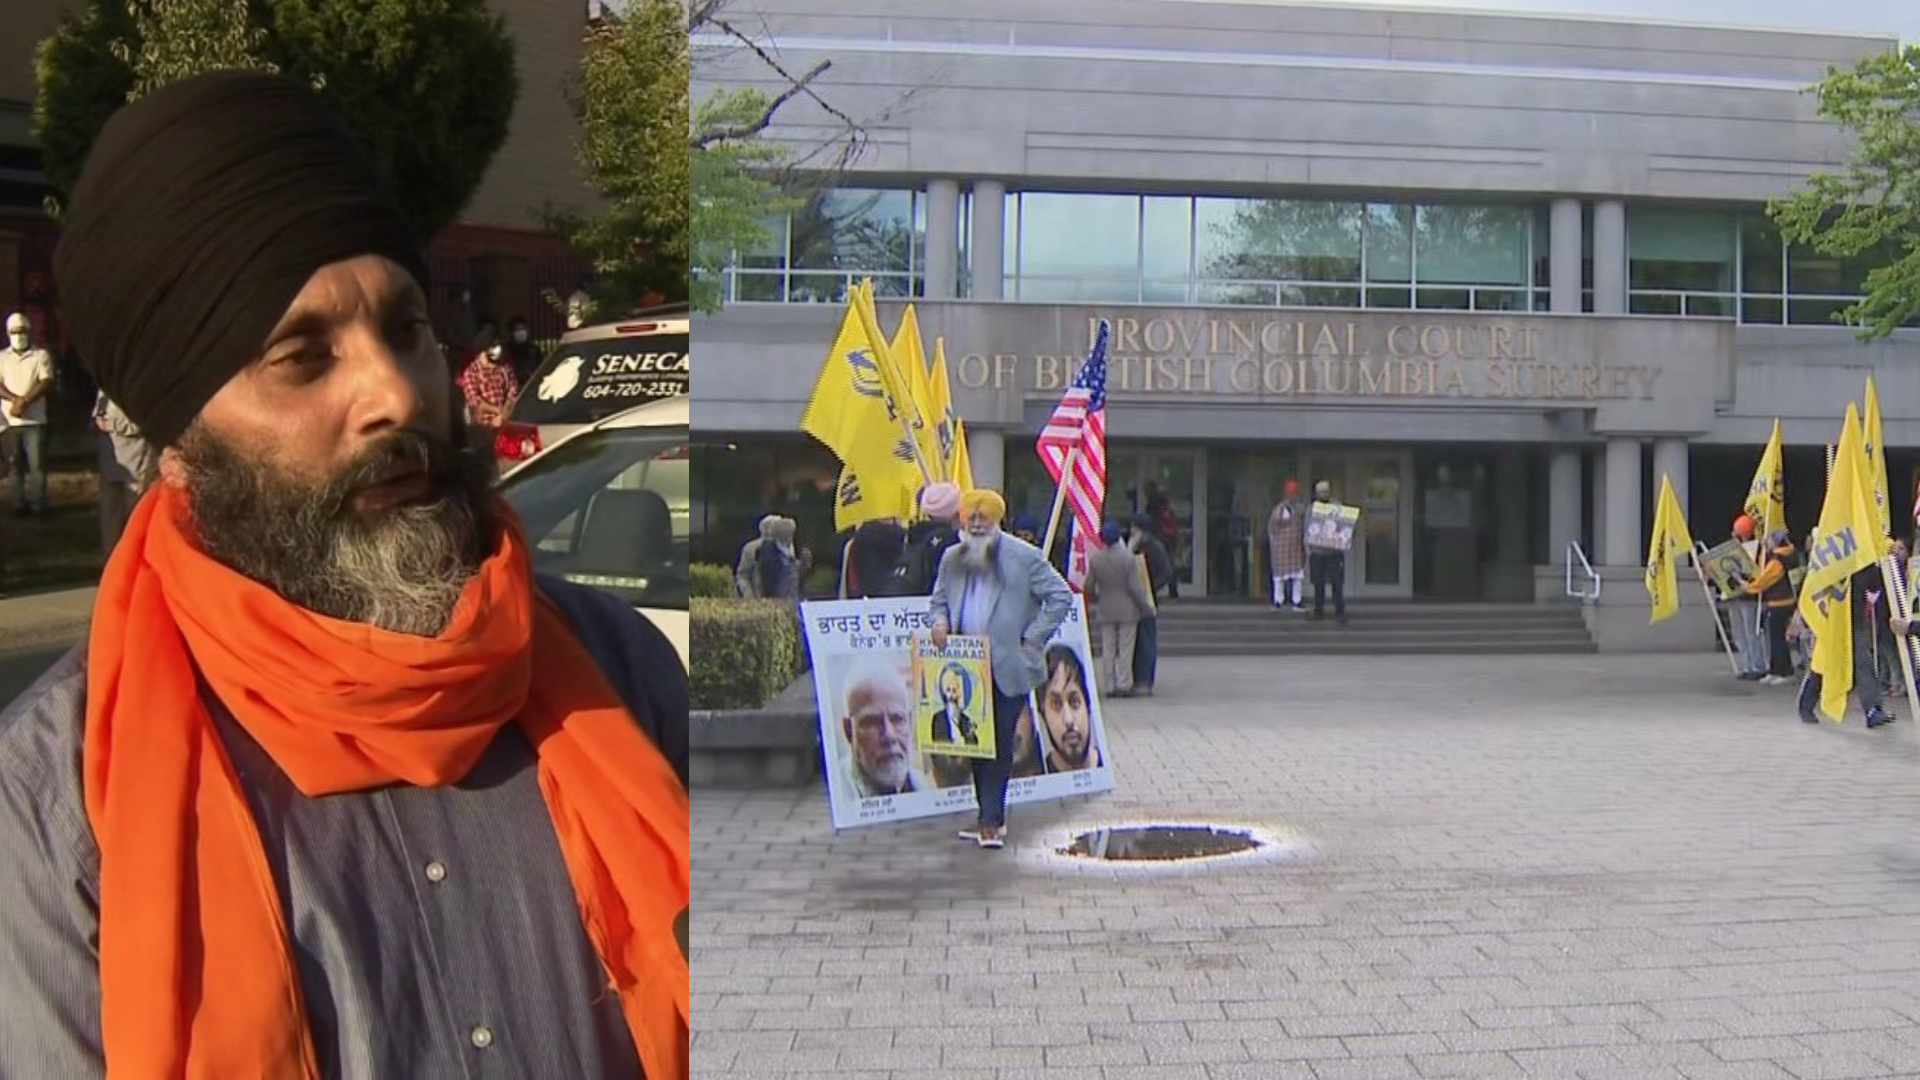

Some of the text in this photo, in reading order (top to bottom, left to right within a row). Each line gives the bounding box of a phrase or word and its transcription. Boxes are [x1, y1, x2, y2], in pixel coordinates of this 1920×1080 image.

[1387, 323, 1545, 361] COURT
[592, 352, 689, 374] SENECA
[958, 353, 1664, 400] OF BTISH COLUMBIA SURREY
[583, 381, 684, 399] 604-720-2331
[817, 613, 861, 634] ਭਾਰਤ
[867, 613, 887, 631] ਦਾ
[919, 637, 985, 648] KHLISTAN
